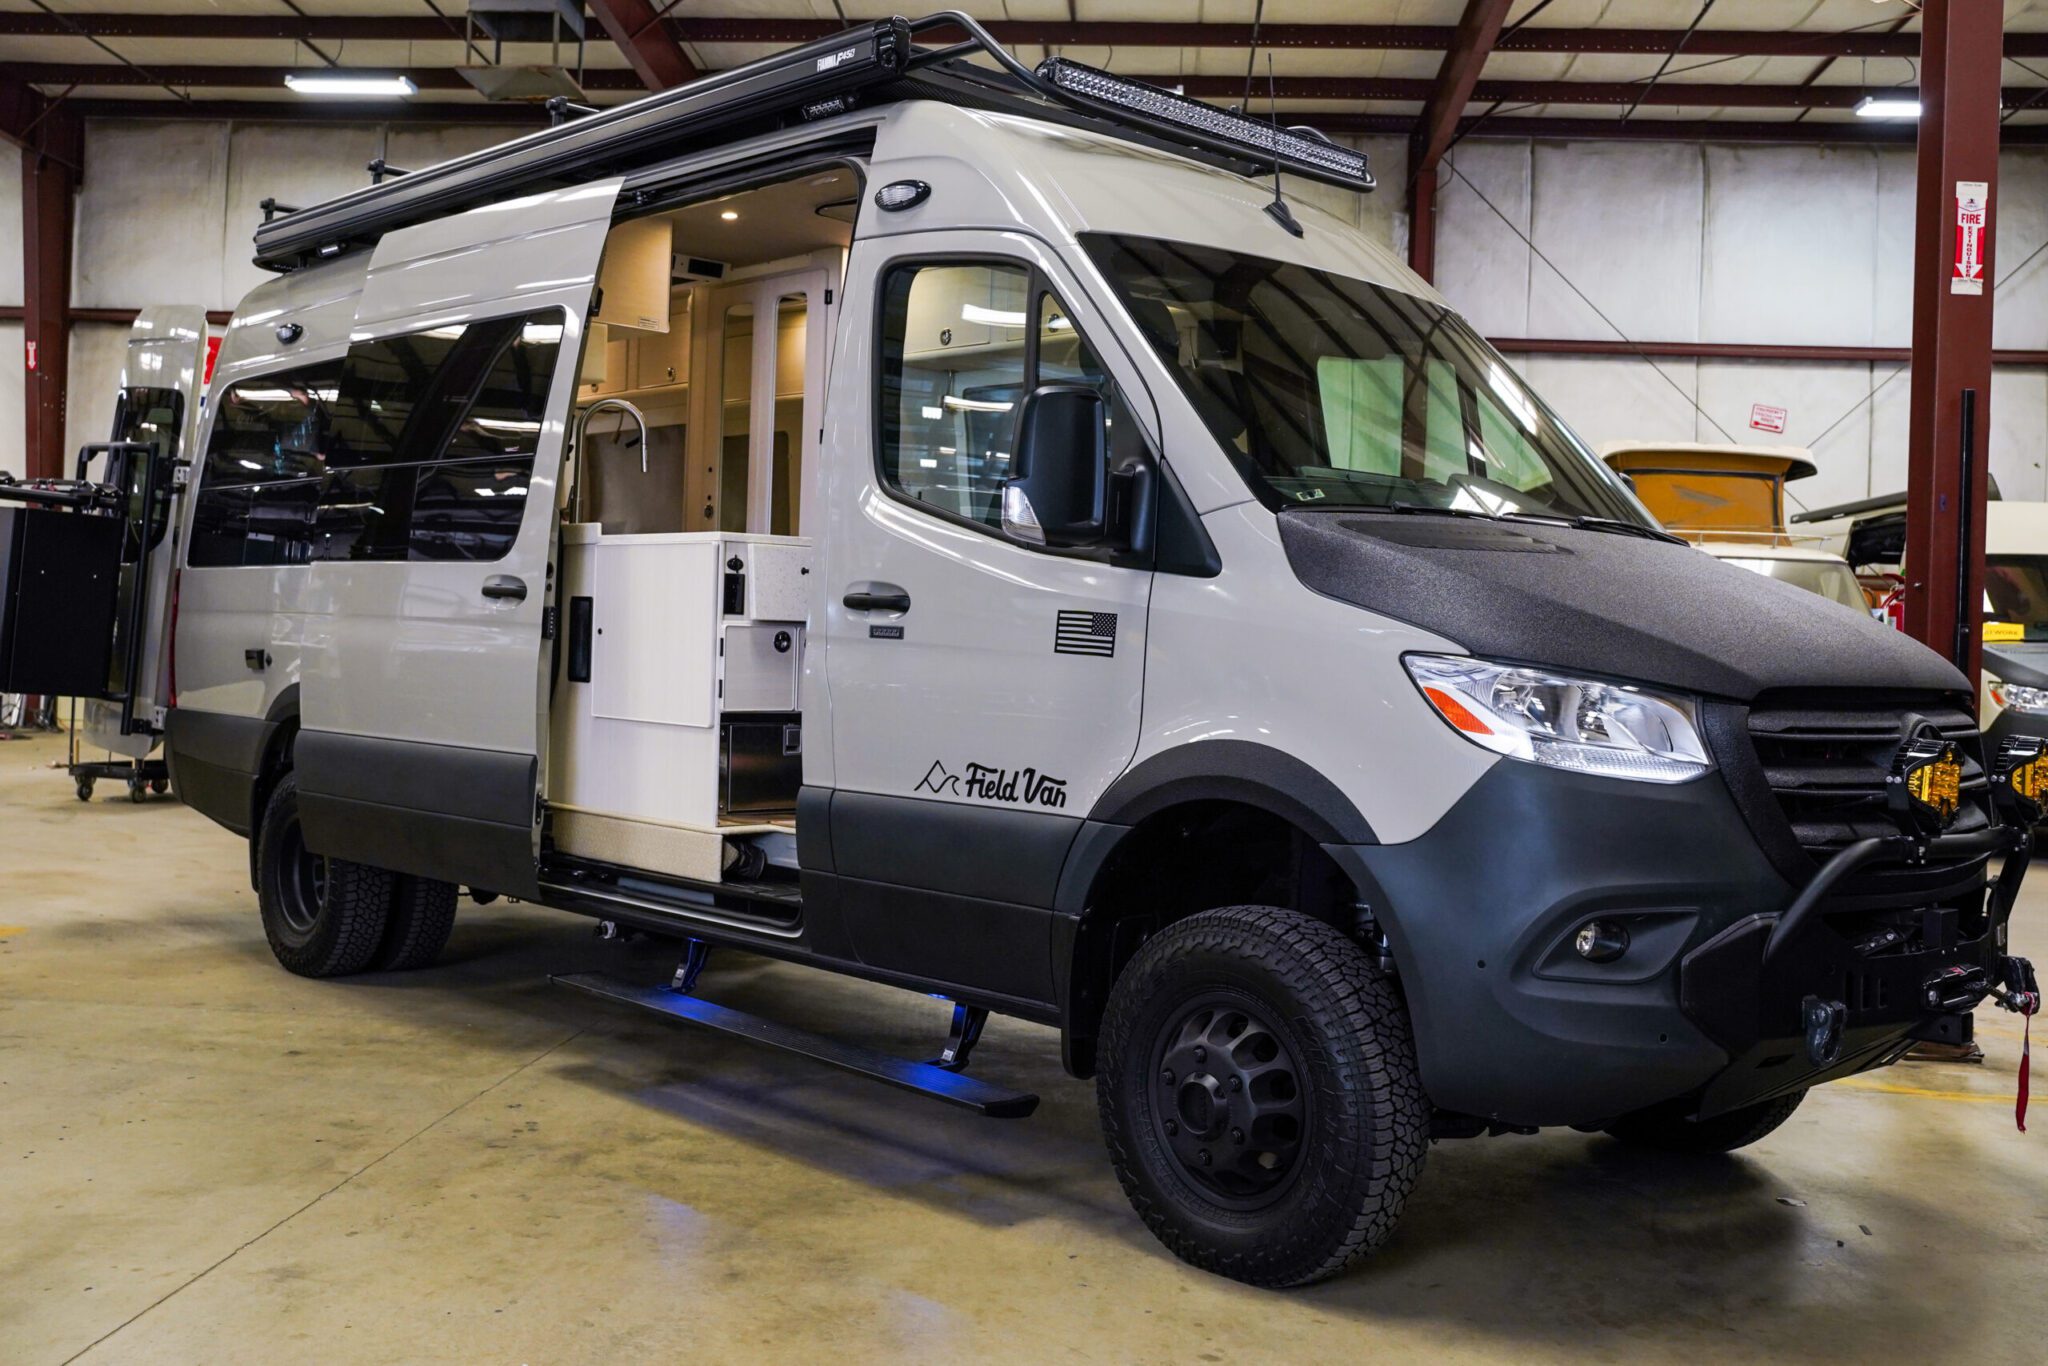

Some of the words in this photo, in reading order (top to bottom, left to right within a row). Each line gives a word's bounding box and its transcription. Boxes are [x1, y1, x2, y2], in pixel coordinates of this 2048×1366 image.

[1961, 213, 1982, 225] FIRE
[1965, 226, 1973, 278] EXTINGUISHER
[965, 762, 1019, 802] Field
[1022, 767, 1067, 808] Van
